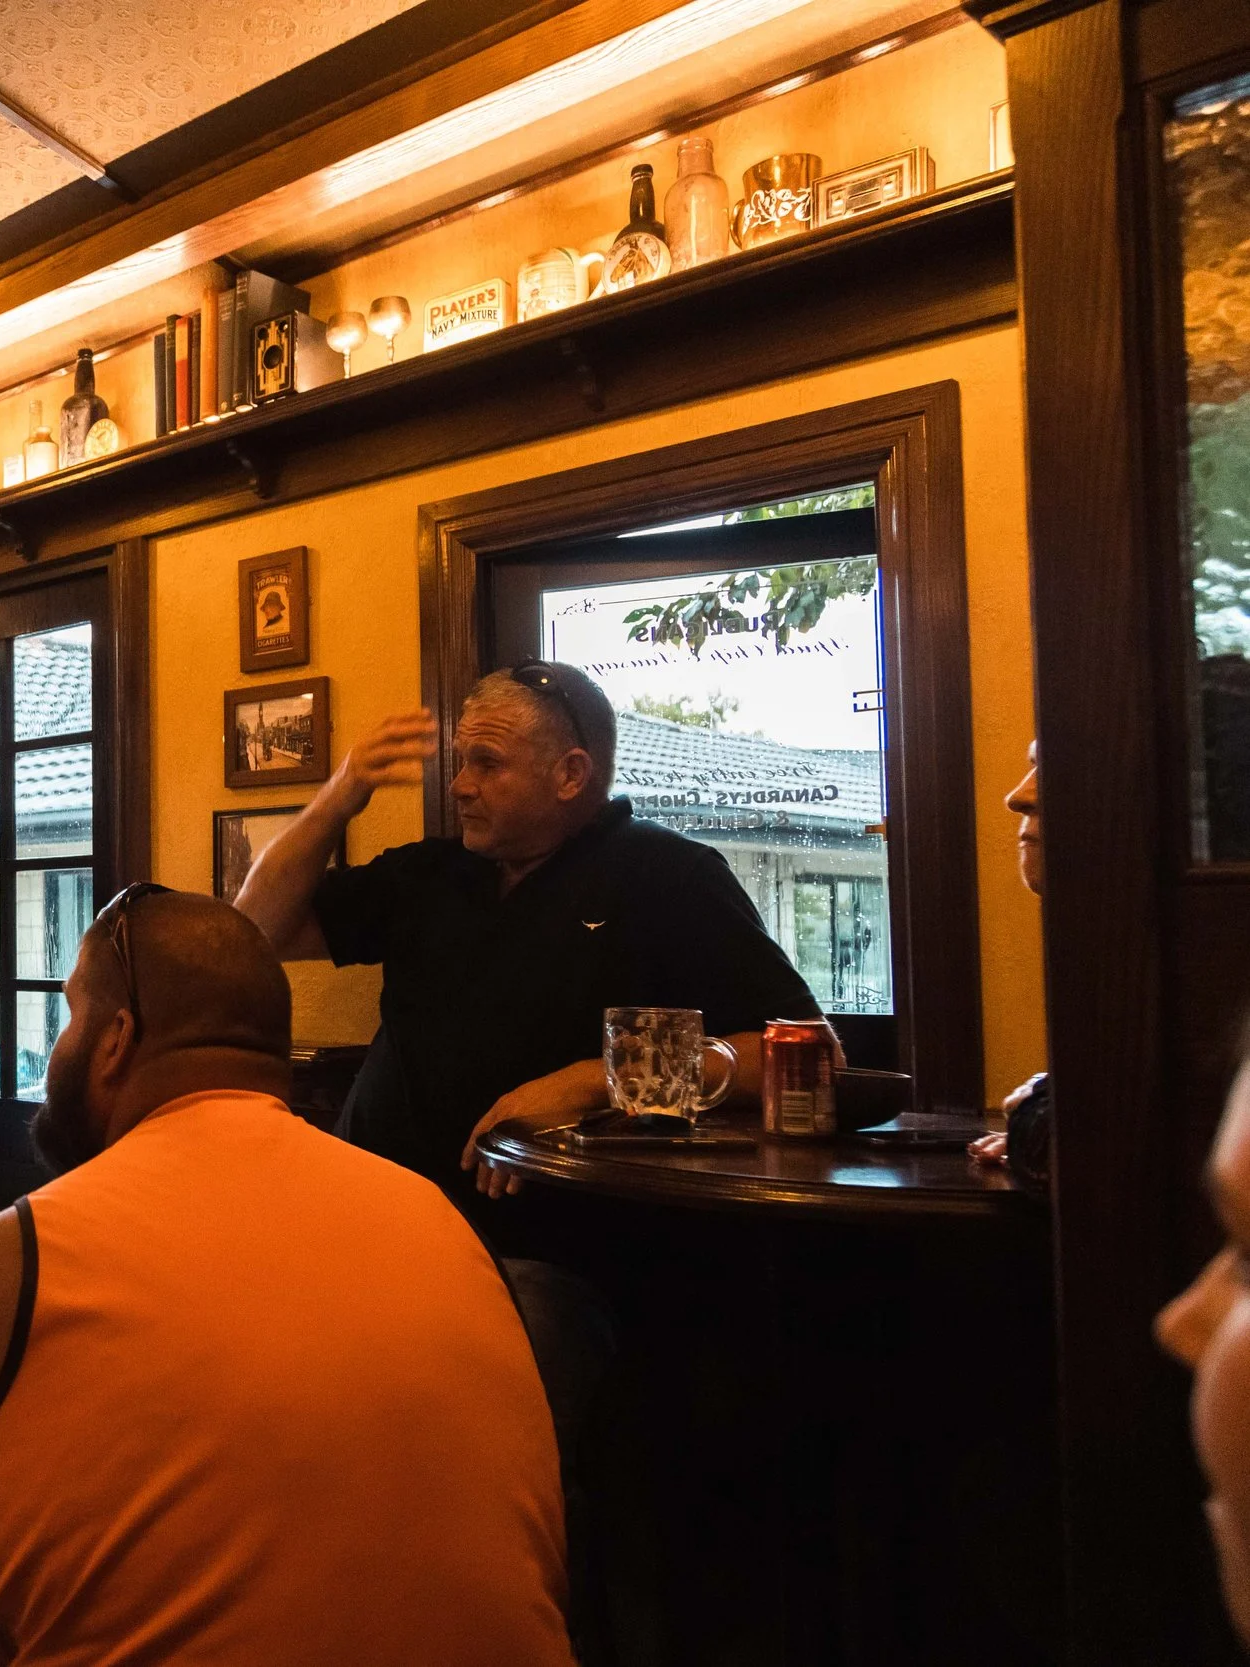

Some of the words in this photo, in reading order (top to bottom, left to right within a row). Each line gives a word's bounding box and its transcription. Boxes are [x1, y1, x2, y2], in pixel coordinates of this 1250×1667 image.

[430, 288, 497, 327] PLAYER'S
[432, 317, 455, 339] NAVY
[460, 309, 498, 324] MIXTURE
